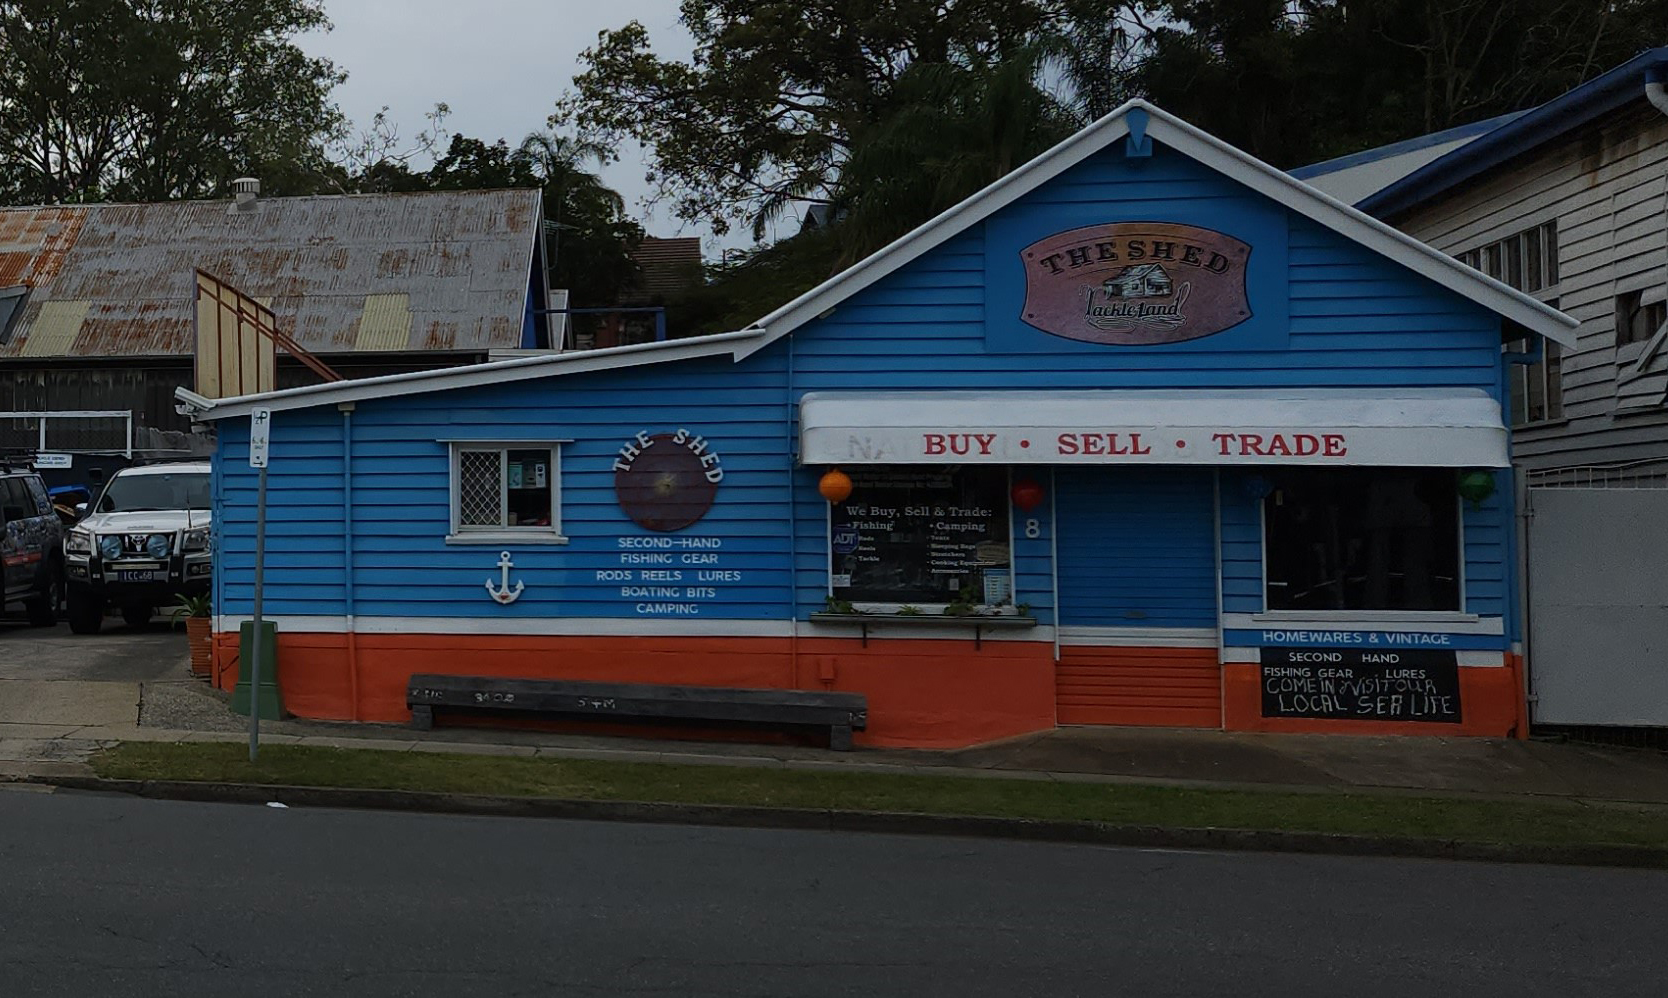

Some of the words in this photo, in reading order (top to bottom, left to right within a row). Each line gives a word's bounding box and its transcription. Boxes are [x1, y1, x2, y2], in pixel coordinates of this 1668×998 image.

[1040, 242, 1119, 275] THE
[1127, 240, 1230, 275] SHED
[923, 433, 997, 455] BUY
[1058, 433, 1151, 455] SELL
[1212, 433, 1347, 457] TRADE
[612, 430, 655, 472] THE
[672, 428, 724, 483] SHED
[846, 506, 867, 517] We
[870, 506, 900, 518] Buy,
[904, 506, 930, 517] Sell
[934, 506, 945, 517] &
[949, 506, 992, 517] Trade:
[852, 520, 895, 531] Fishing
[936, 521, 987, 532] Camping
[1024, 518, 1041, 539] 8
[833, 532, 857, 545] ADT
[620, 553, 673, 564] FISHING
[681, 553, 719, 564] GEAR
[596, 570, 633, 581] RODS
[641, 570, 683, 581] REELS
[698, 570, 742, 581] LURES
[621, 586, 680, 597] BOATING
[686, 587, 716, 598] BITS
[636, 602, 699, 614] CAMPING
[1262, 630, 1363, 643] HOMEWARES
[1368, 632, 1380, 644] &
[1385, 633, 1451, 645] VINTAGE
[1288, 652, 1343, 663] SECOND
[1361, 653, 1401, 664] HAND
[1264, 667, 1311, 677] FISHING
[1317, 668, 1354, 679] GEAR
[1385, 669, 1427, 680] LURES
[1266, 677, 1317, 695] COME
[1279, 694, 1348, 713] LOCAL
[1357, 695, 1402, 716] SEA
